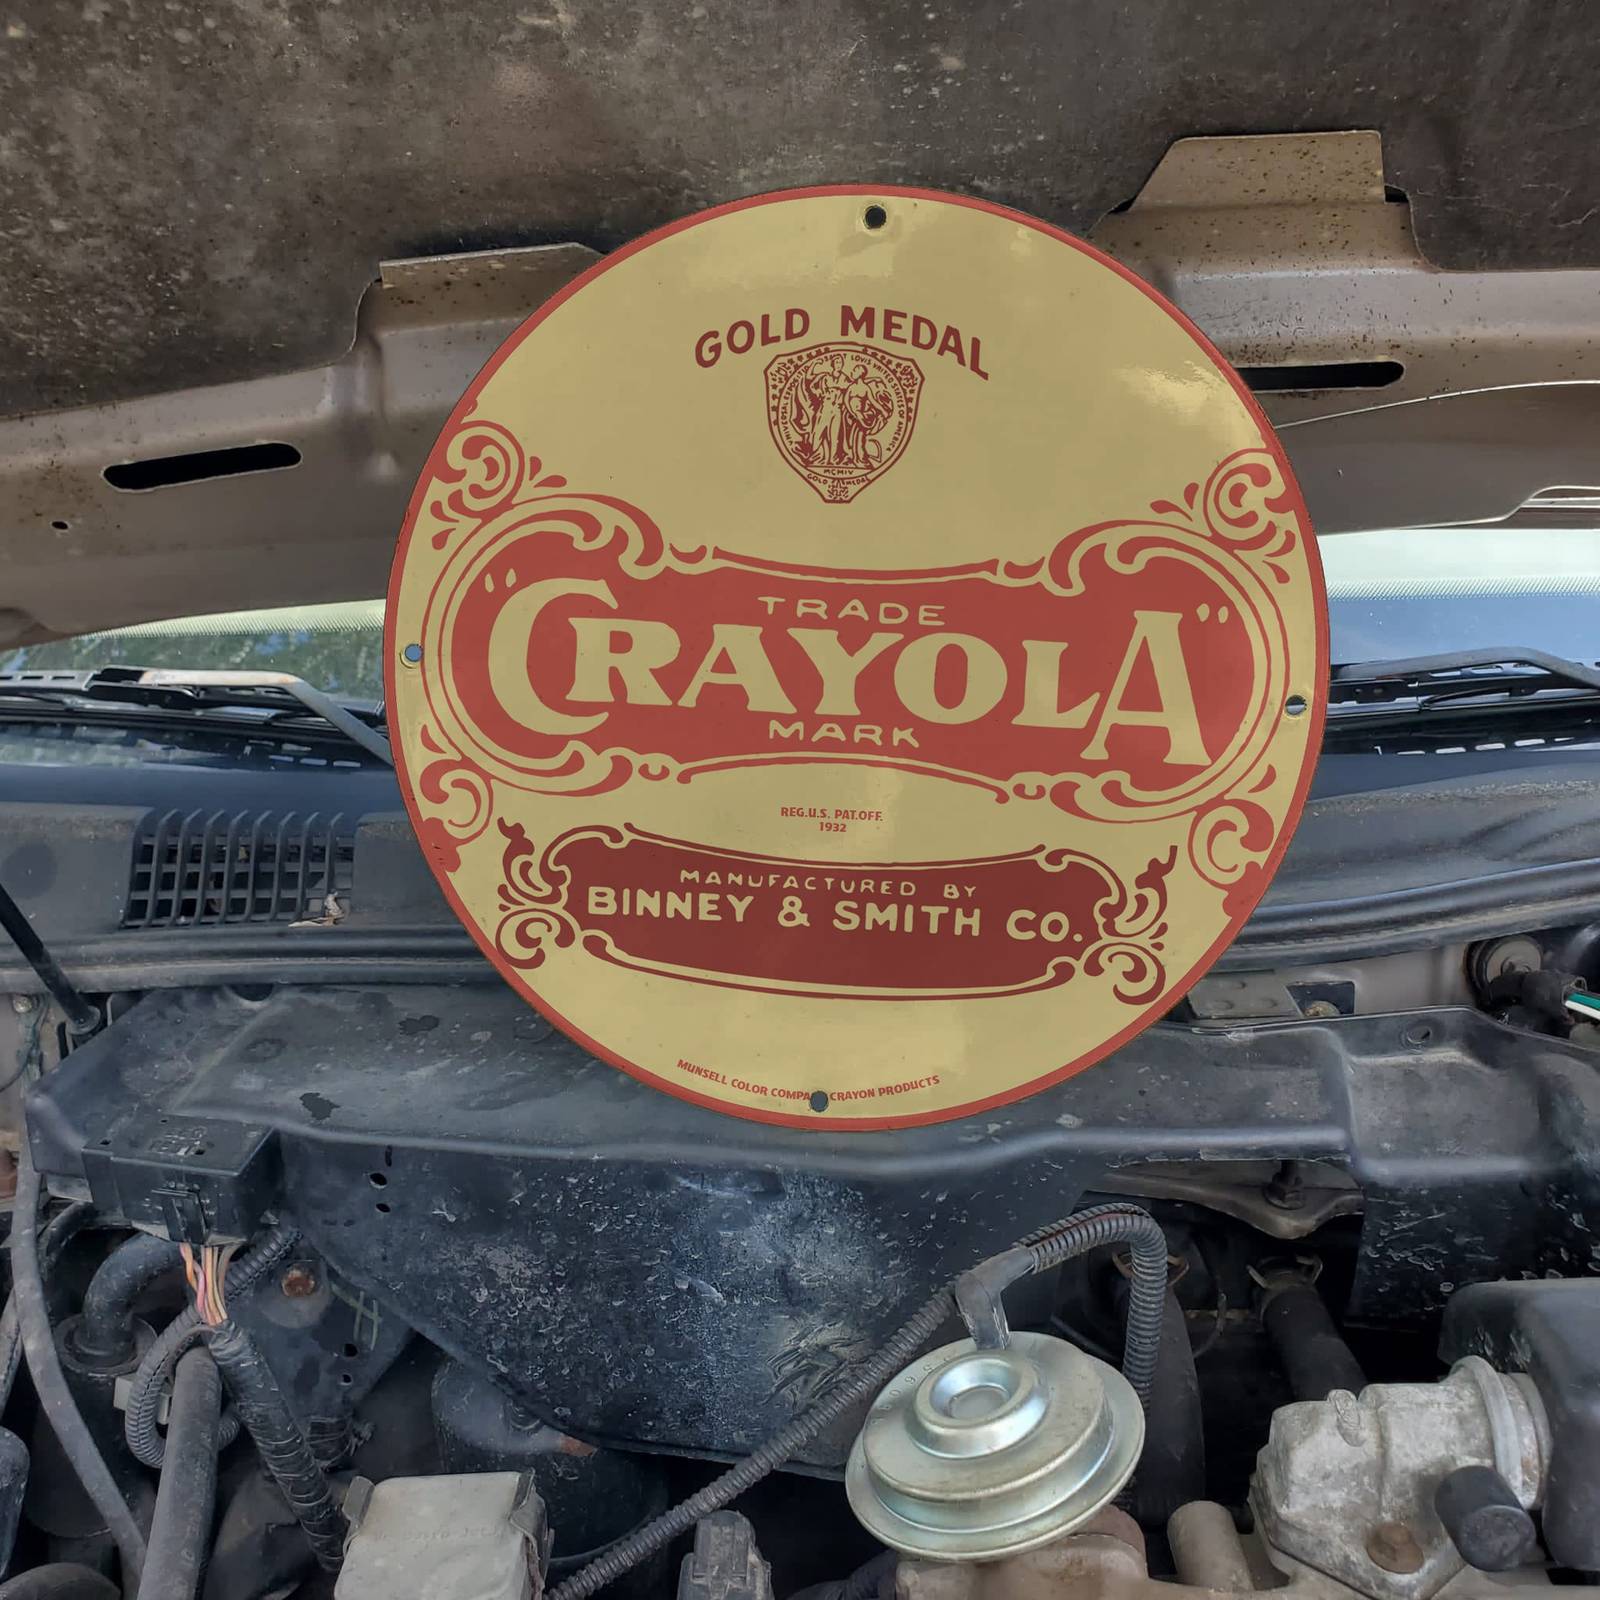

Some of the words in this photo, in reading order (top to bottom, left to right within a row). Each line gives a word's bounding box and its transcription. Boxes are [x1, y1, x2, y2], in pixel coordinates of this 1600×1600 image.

[695, 308, 809, 368] GOLD
[841, 305, 989, 381] MEDAL
[758, 596, 945, 626] TRADE
[769, 719, 919, 748] MARK
[819, 822, 847, 832] 1932
[680, 869, 916, 896] MANUFACTURED
[943, 884, 977, 898] BY
[587, 886, 754, 922] BINNEY
[777, 896, 810, 927] &
[832, 900, 981, 936] SMITH
[1006, 909, 1084, 942] CO.
[677, 1059, 728, 1085] MUNSELL
[731, 1078, 768, 1097] COLOR
[770, 1087, 811, 1101] COMPA
[829, 1088, 876, 1101] CRAYON
[877, 1074, 941, 1097] PRODUCTS
